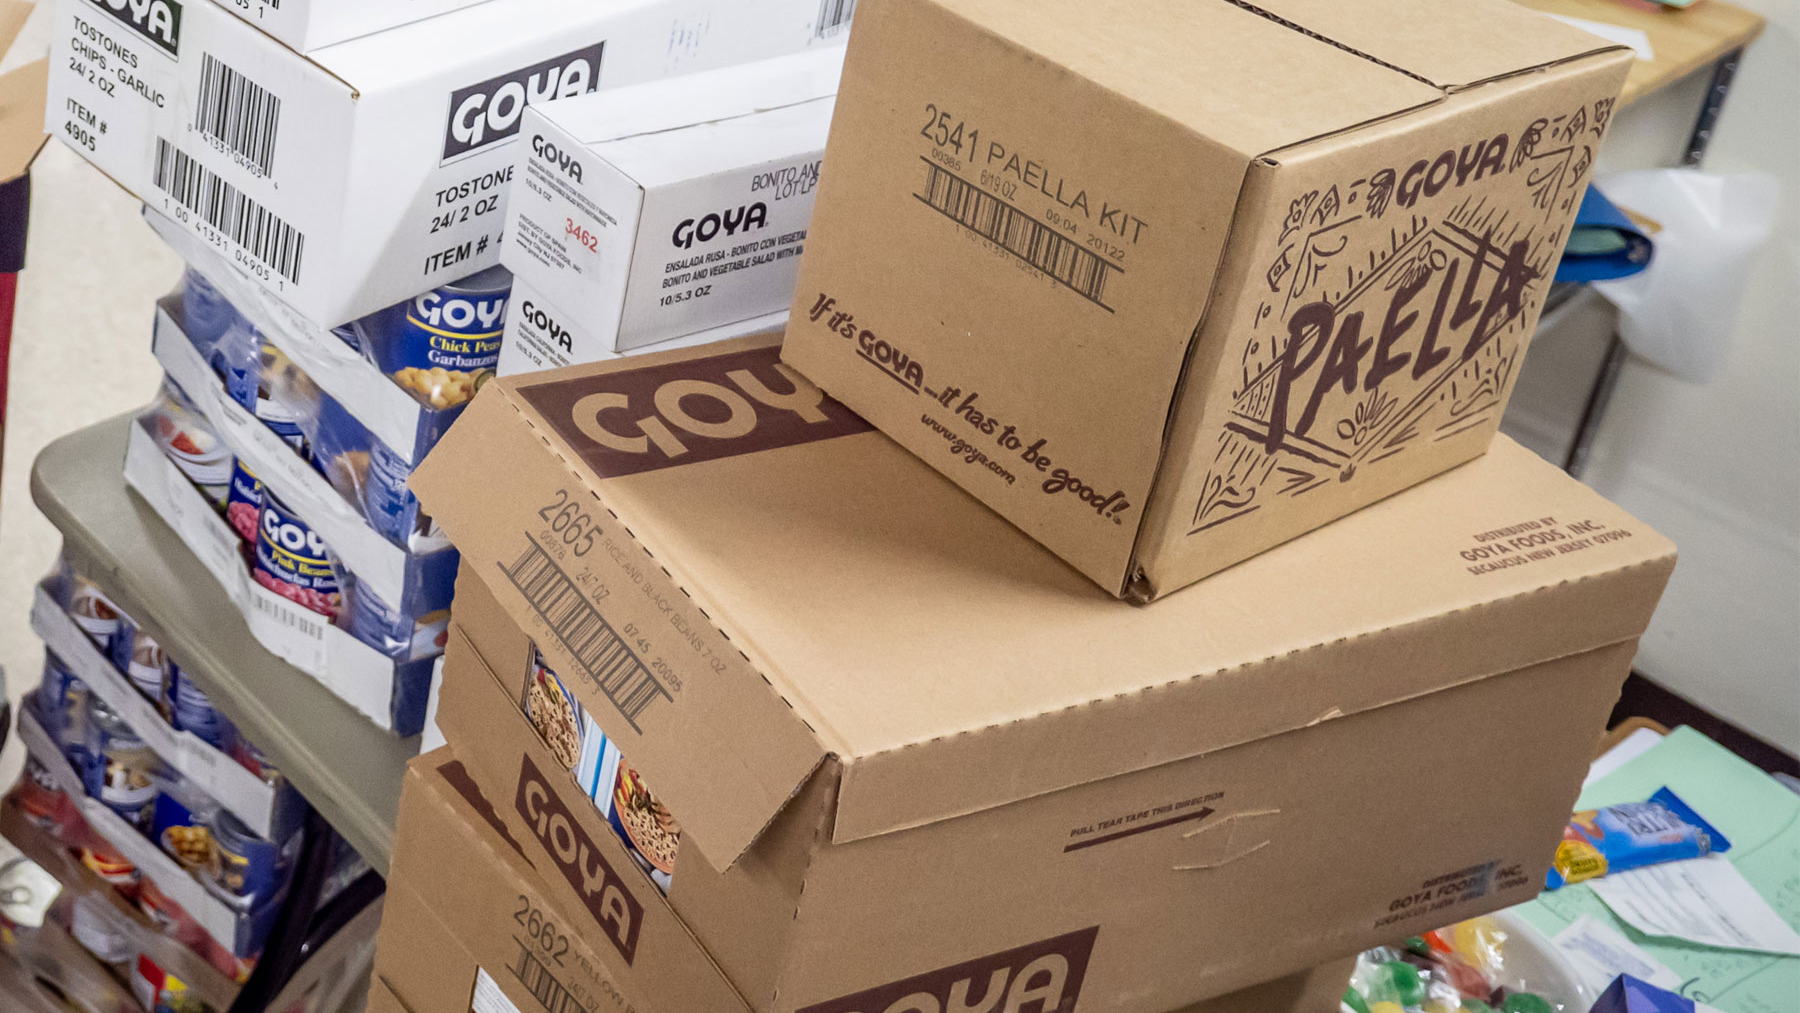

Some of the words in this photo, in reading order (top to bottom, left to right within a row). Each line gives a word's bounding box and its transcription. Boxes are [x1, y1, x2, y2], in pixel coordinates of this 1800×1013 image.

[73, 15, 138, 69] TOSTONES
[71, 38, 106, 71] CHIPS
[117, 67, 165, 109] GARLIC
[66, 97, 96, 129] ITEM
[99, 120, 107, 135] #
[452, 58, 591, 146] GOYA
[64, 119, 96, 152] 4905
[532, 134, 583, 185] GOYA
[751, 167, 797, 191] BONITO
[920, 103, 979, 163] 2541
[987, 141, 1090, 219] PAELLA
[1099, 201, 1149, 245] KIT
[1396, 133, 1509, 209] GOYA
[436, 164, 514, 207] TOSTONE
[775, 180, 800, 200] LOT
[1002, 181, 1018, 202] OZ
[565, 217, 598, 253] 3462
[672, 202, 767, 250] GOYA
[1046, 208, 1077, 235] 09:04
[1086, 233, 1127, 262] 20122
[424, 241, 471, 276] ITEM
[476, 234, 488, 256] #
[662, 273, 691, 289] BONITO
[692, 268, 708, 281] AND
[709, 257, 751, 276] VEGETABLE
[751, 251, 775, 267] SALAD
[665, 256, 704, 273] ENSALADA
[705, 249, 726, 264] RUSA
[731, 241, 759, 258] BONITO
[760, 237, 776, 251] CON
[416, 290, 510, 329] GOY
[660, 290, 692, 307] 10/5.3
[694, 284, 712, 298] OZ
[430, 335, 471, 354] Chick
[523, 300, 573, 354] GOYA
[1265, 228, 1543, 455] PAELLA
[809, 292, 836, 322] If
[827, 311, 857, 339] it's
[858, 329, 924, 388] GOYA
[954, 392, 999, 436] has
[996, 425, 1023, 451] to
[1020, 437, 1051, 472] be
[1042, 467, 1130, 519] good!
[921, 413, 1016, 486] www.goya.com
[1460, 543, 1512, 562] GOYA
[1510, 529, 1572, 551] FOODS,
[1473, 520, 1542, 543] DISTRIBUTED
[1540, 516, 1558, 527] BY
[1466, 556, 1528, 575] SECAUCUS
[1528, 549, 1556, 562] NEW
[1555, 539, 1594, 555] JERSEY
[1592, 529, 1633, 544] 07096
[538, 489, 603, 557] 2665
[602, 538, 624, 566] RICE
[623, 562, 643, 585] AND
[641, 581, 673, 619] BLACK
[670, 614, 706, 652] BEANS
[710, 656, 727, 676] OZ
[652, 657, 683, 692] 20095
[1070, 824, 1095, 837] PULL
[1097, 817, 1124, 831] TEAR
[1125, 809, 1150, 824] TAPE
[1151, 803, 1174, 817] THIS
[525, 779, 631, 948] GOYA
[513, 894, 569, 968] 2662
